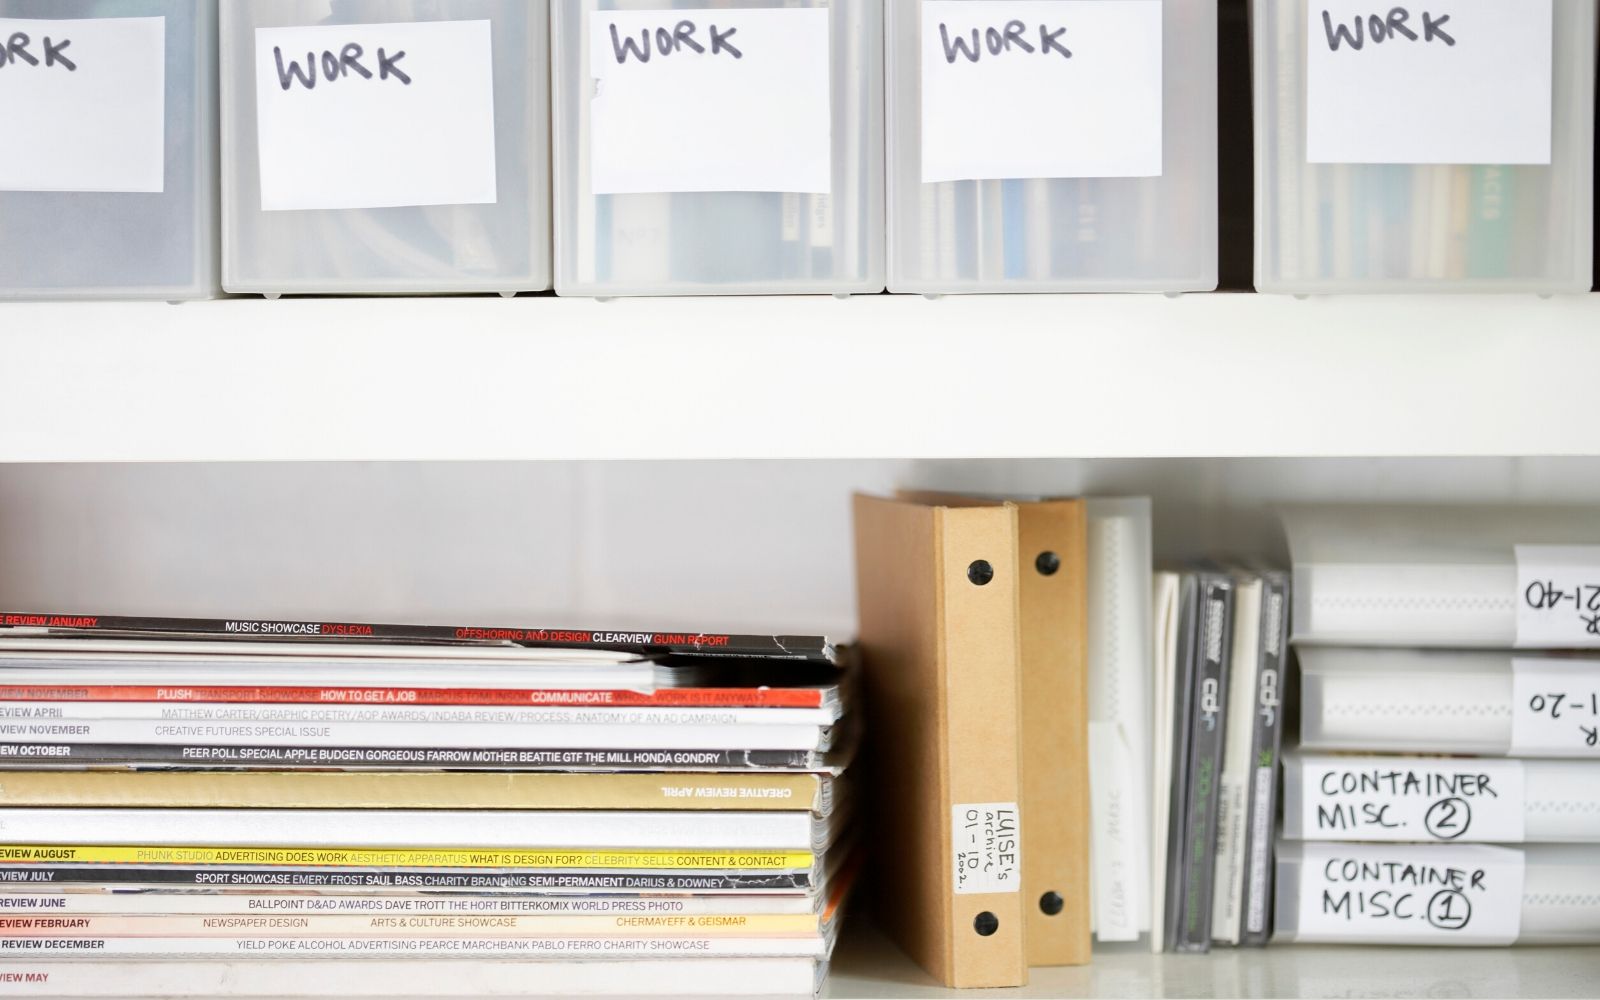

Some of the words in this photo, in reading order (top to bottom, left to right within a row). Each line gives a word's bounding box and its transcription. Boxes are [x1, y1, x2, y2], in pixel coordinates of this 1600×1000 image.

[1322, 7, 1456, 52] WORK
[609, 19, 742, 64] WORK
[939, 19, 1072, 64] WORK
[273, 42, 411, 90] WORK
[6, 615, 47, 625] REVIEW
[48, 616, 97, 627] JANUARY
[225, 622, 260, 633] MUSIC
[261, 623, 320, 634] SHOWCASE
[322, 624, 373, 635] DYSLEXIA
[456, 629, 523, 640] OFFSHORING
[525, 631, 548, 641] AND
[550, 632, 590, 642] DESIGN
[592, 633, 652, 644] CLEARVIEW
[654, 635, 685, 645] GUNN
[687, 635, 729, 646] REPORT
[27, 688, 88, 698] NOVEMBER
[157, 689, 192, 699] PLUSH
[259, 690, 318, 700] SHOWCASE
[321, 691, 347, 701] HOW
[349, 691, 362, 701] TO
[363, 691, 384, 701] GET
[385, 691, 395, 701] A
[396, 691, 416, 701] JOB
[531, 692, 612, 703] COMMUNICATE
[656, 693, 688, 702] WORK
[689, 693, 702, 702] IS
[34, 708, 62, 718] APRIL
[162, 709, 212, 719] MATTHEW
[576, 712, 627, 722] ANATOMY
[630, 713, 643, 723] OF
[646, 713, 661, 723] AN
[664, 714, 678, 723] AD
[681, 714, 737, 724] CAMPAIGN
[29, 725, 90, 735] NOVEMBER
[155, 726, 204, 736] CREATIVE
[206, 727, 252, 736] FUTURES
[254, 727, 297, 737] SPECIAL
[300, 728, 330, 737] ISSUE
[20, 745, 71, 756] OCTOBER
[182, 748, 210, 758] PEER
[212, 748, 238, 758] POLL
[239, 749, 283, 759] SPECIAL
[284, 749, 317, 760] APPLE
[319, 750, 364, 760] BUDGEN
[366, 750, 425, 761] GORGEOUS
[427, 751, 471, 761] FARROW
[473, 752, 518, 762] MOTHER
[520, 752, 560, 762] BEATTIE
[562, 752, 583, 762] GTF
[584, 752, 605, 763] THE
[607, 753, 632, 763] MILL
[634, 753, 672, 763] HONDA
[674, 753, 720, 764] GONDRY
[661, 787, 692, 797] APRIL
[1321, 770, 1498, 797] CONTAINER
[695, 788, 737, 797] REVIEW
[739, 788, 792, 797] CREATIVE
[1317, 803, 1408, 830] MISC.
[984, 812, 996, 873] archive
[34, 849, 76, 859] AUGUST
[137, 851, 173, 860] PHUNK
[176, 851, 213, 860] STUDIO
[215, 851, 284, 861] ADVERTISING
[286, 852, 314, 862] DOES
[316, 852, 348, 862] WORK
[350, 853, 405, 863] AESTHETIC
[408, 854, 467, 863] APPARATUS
[469, 854, 499, 864] WHAT
[501, 855, 511, 864] IS
[513, 855, 553, 865] DESIGN
[555, 855, 583, 865] FOR?
[585, 855, 640, 865] CELEBRITY
[642, 856, 674, 865] SELLS
[676, 856, 726, 866] CONTENT
[728, 856, 736, 866] &
[738, 856, 787, 866] CONTACT
[30, 871, 55, 881] JULY
[195, 873, 230, 884] SPORT
[231, 874, 291, 884] SHOWCASE
[292, 875, 328, 885] EMERY
[330, 875, 364, 885] FROST
[365, 875, 393, 886] SAUL
[395, 876, 423, 886] BASS
[424, 876, 470, 886] CHARITY
[471, 877, 526, 887] BRANDING
[528, 877, 624, 887] SEMI-PERMANENT
[626, 877, 665, 888] DARIUS
[666, 878, 675, 888] &
[677, 878, 725, 888] DOWNEY
[1324, 858, 1486, 891] CONTAINER
[39, 899, 66, 908] JUNE
[248, 900, 304, 909] BALLPOINT
[307, 900, 336, 909] D&AD
[338, 900, 383, 910] AWARDS
[385, 901, 412, 910] DAVE
[414, 901, 445, 910] TROTT
[449, 901, 468, 910] THE
[470, 901, 498, 911] HORT
[500, 901, 570, 911] BITTERKOMIX
[572, 902, 609, 911] WORLD
[612, 902, 646, 911] PRESS
[648, 902, 683, 911] PHOTO
[1323, 890, 1425, 921] MISC.
[34, 919, 90, 928] FEBRUARY
[203, 918, 267, 928] NEWSPAPER
[269, 918, 309, 928] DESIGN
[370, 918, 397, 927] ARTS
[399, 918, 407, 927] &
[409, 918, 457, 927] CULTURE
[458, 918, 517, 927] SHOWCASE
[616, 917, 686, 926] CHERMAYEFF
[688, 917, 696, 926] &
[698, 917, 747, 926] GEISMAR
[2, 940, 43, 949] REVIEW
[44, 940, 105, 949] DECEMBER
[236, 940, 266, 949] YIELD
[268, 940, 296, 949] POKE
[298, 940, 347, 949] ALCOHOL
[348, 940, 417, 949] ADVERTISING
[419, 940, 460, 950] PEARCE
[462, 940, 530, 950] MARCHBANK
[532, 940, 565, 950] PABLO
[567, 940, 601, 950] FERRO
[604, 940, 648, 950] CHARITY
[650, 940, 710, 950] SHOWCASE
[25, 973, 49, 982] MAY
